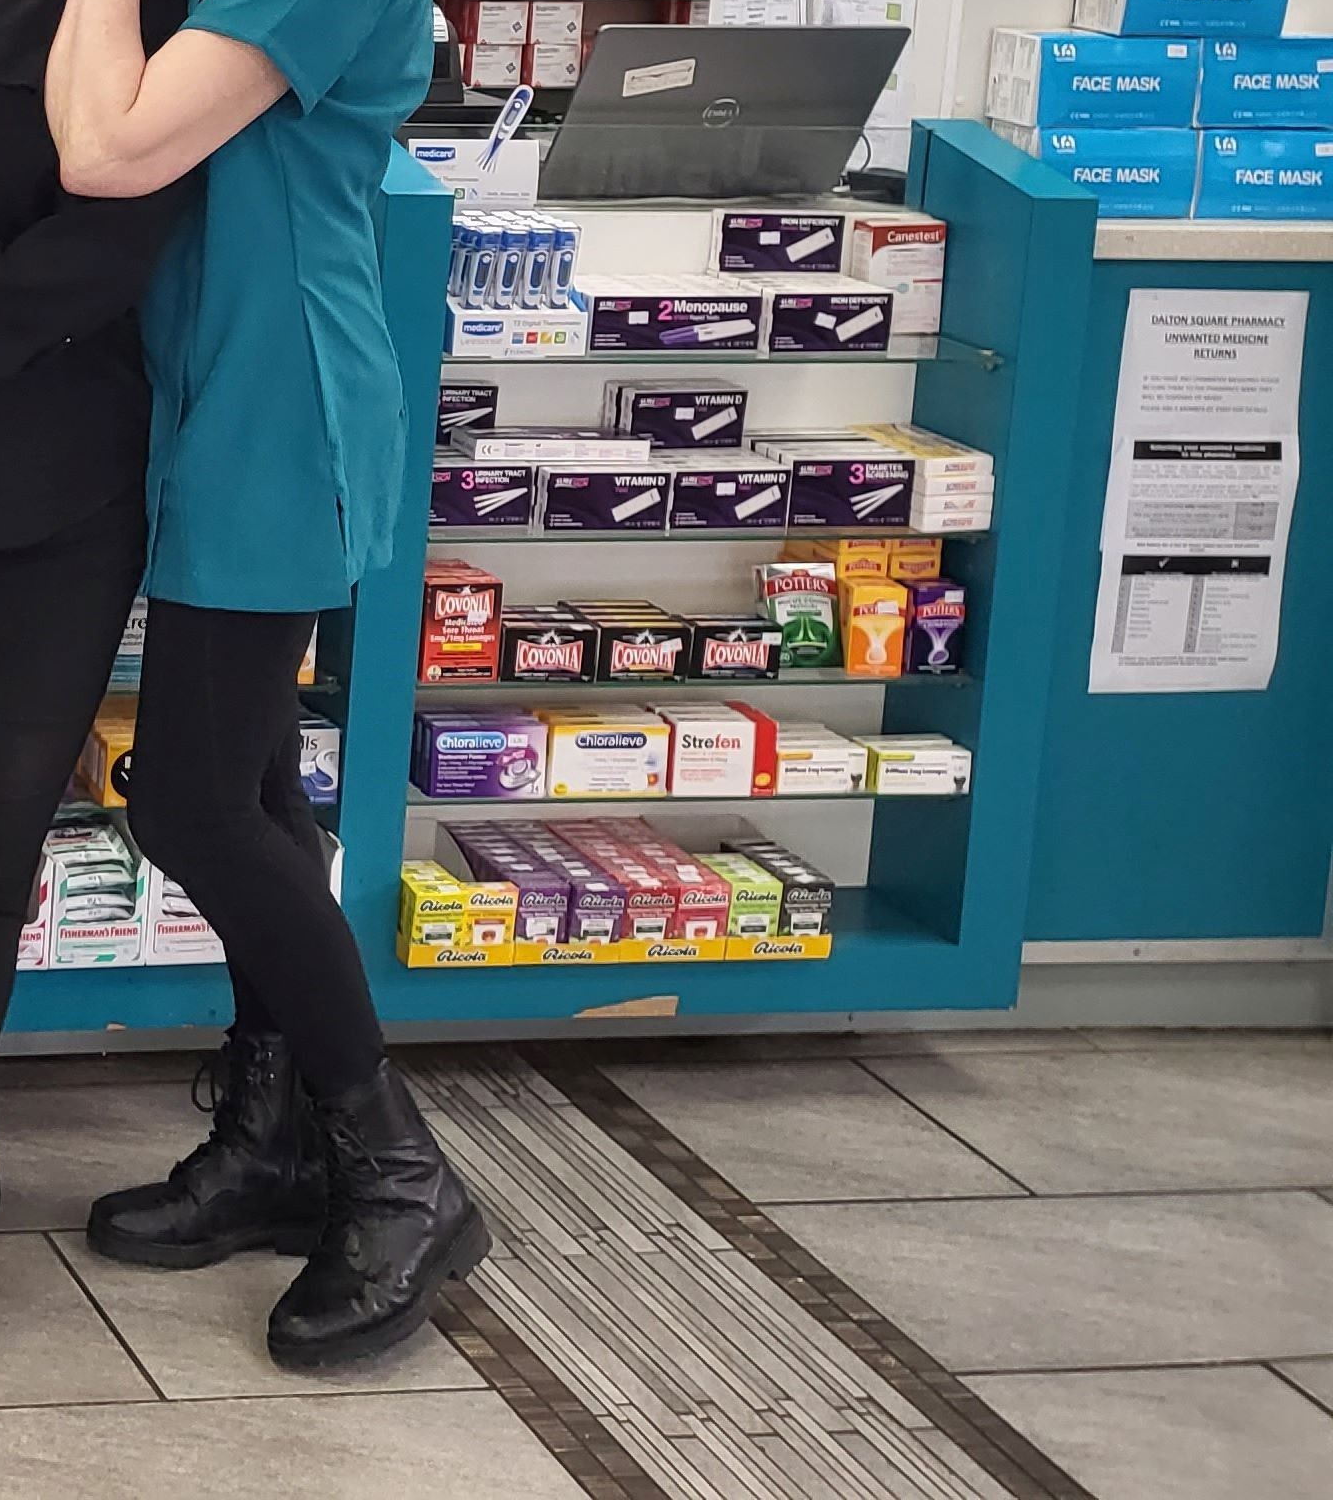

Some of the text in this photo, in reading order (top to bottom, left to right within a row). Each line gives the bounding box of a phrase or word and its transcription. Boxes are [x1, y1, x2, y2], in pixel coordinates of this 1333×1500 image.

[1072, 77, 1161, 91] FACE MASK
[1234, 74, 1319, 89] FACE MASK
[416, 147, 455, 159] medicare
[1074, 168, 1159, 183] FACE MASK
[1235, 170, 1322, 185] FACE MASK
[888, 229, 939, 243] Canestest
[658, 300, 748, 321] 2 Menopause
[464, 321, 503, 334] medicare
[1152, 315, 1285, 327] DALTON SQUARE PHARMACY
[1165, 333, 1268, 344] UNWANTED MEDICINE
[1194, 349, 1237, 359] RETURNS
[695, 395, 743, 405] VITAMIN D
[461, 471, 474, 490] 3
[738, 473, 786, 484] VITAMIN D
[849, 464, 864, 484] 3
[615, 476, 666, 487] VITAMIN D
[775, 577, 829, 593] POTTERS
[438, 594, 492, 616] COVONIA
[519, 648, 579, 671] COVONIA
[615, 647, 674, 670] COVONIA
[707, 644, 766, 666] COVONIA
[440, 736, 502, 749] Chloralieve
[577, 734, 643, 747] Chloralieve
[682, 734, 741, 749] Strefen
[470, 893, 514, 906] Ricola
[523, 892, 566, 906] Ricola
[581, 894, 624, 907] Ricola
[631, 894, 673, 907] Ricola
[684, 891, 727, 904] Ricola
[736, 890, 778, 902] Ricola
[787, 888, 831, 902] Ricola
[420, 899, 463, 912] Ricola
[60, 926, 138, 939] FISHERMAN'S FRIEND
[542, 948, 592, 960] Ricola
[647, 944, 697, 957] Ricola
[753, 941, 802, 954] Ricola
[436, 950, 486, 962] Ricola
